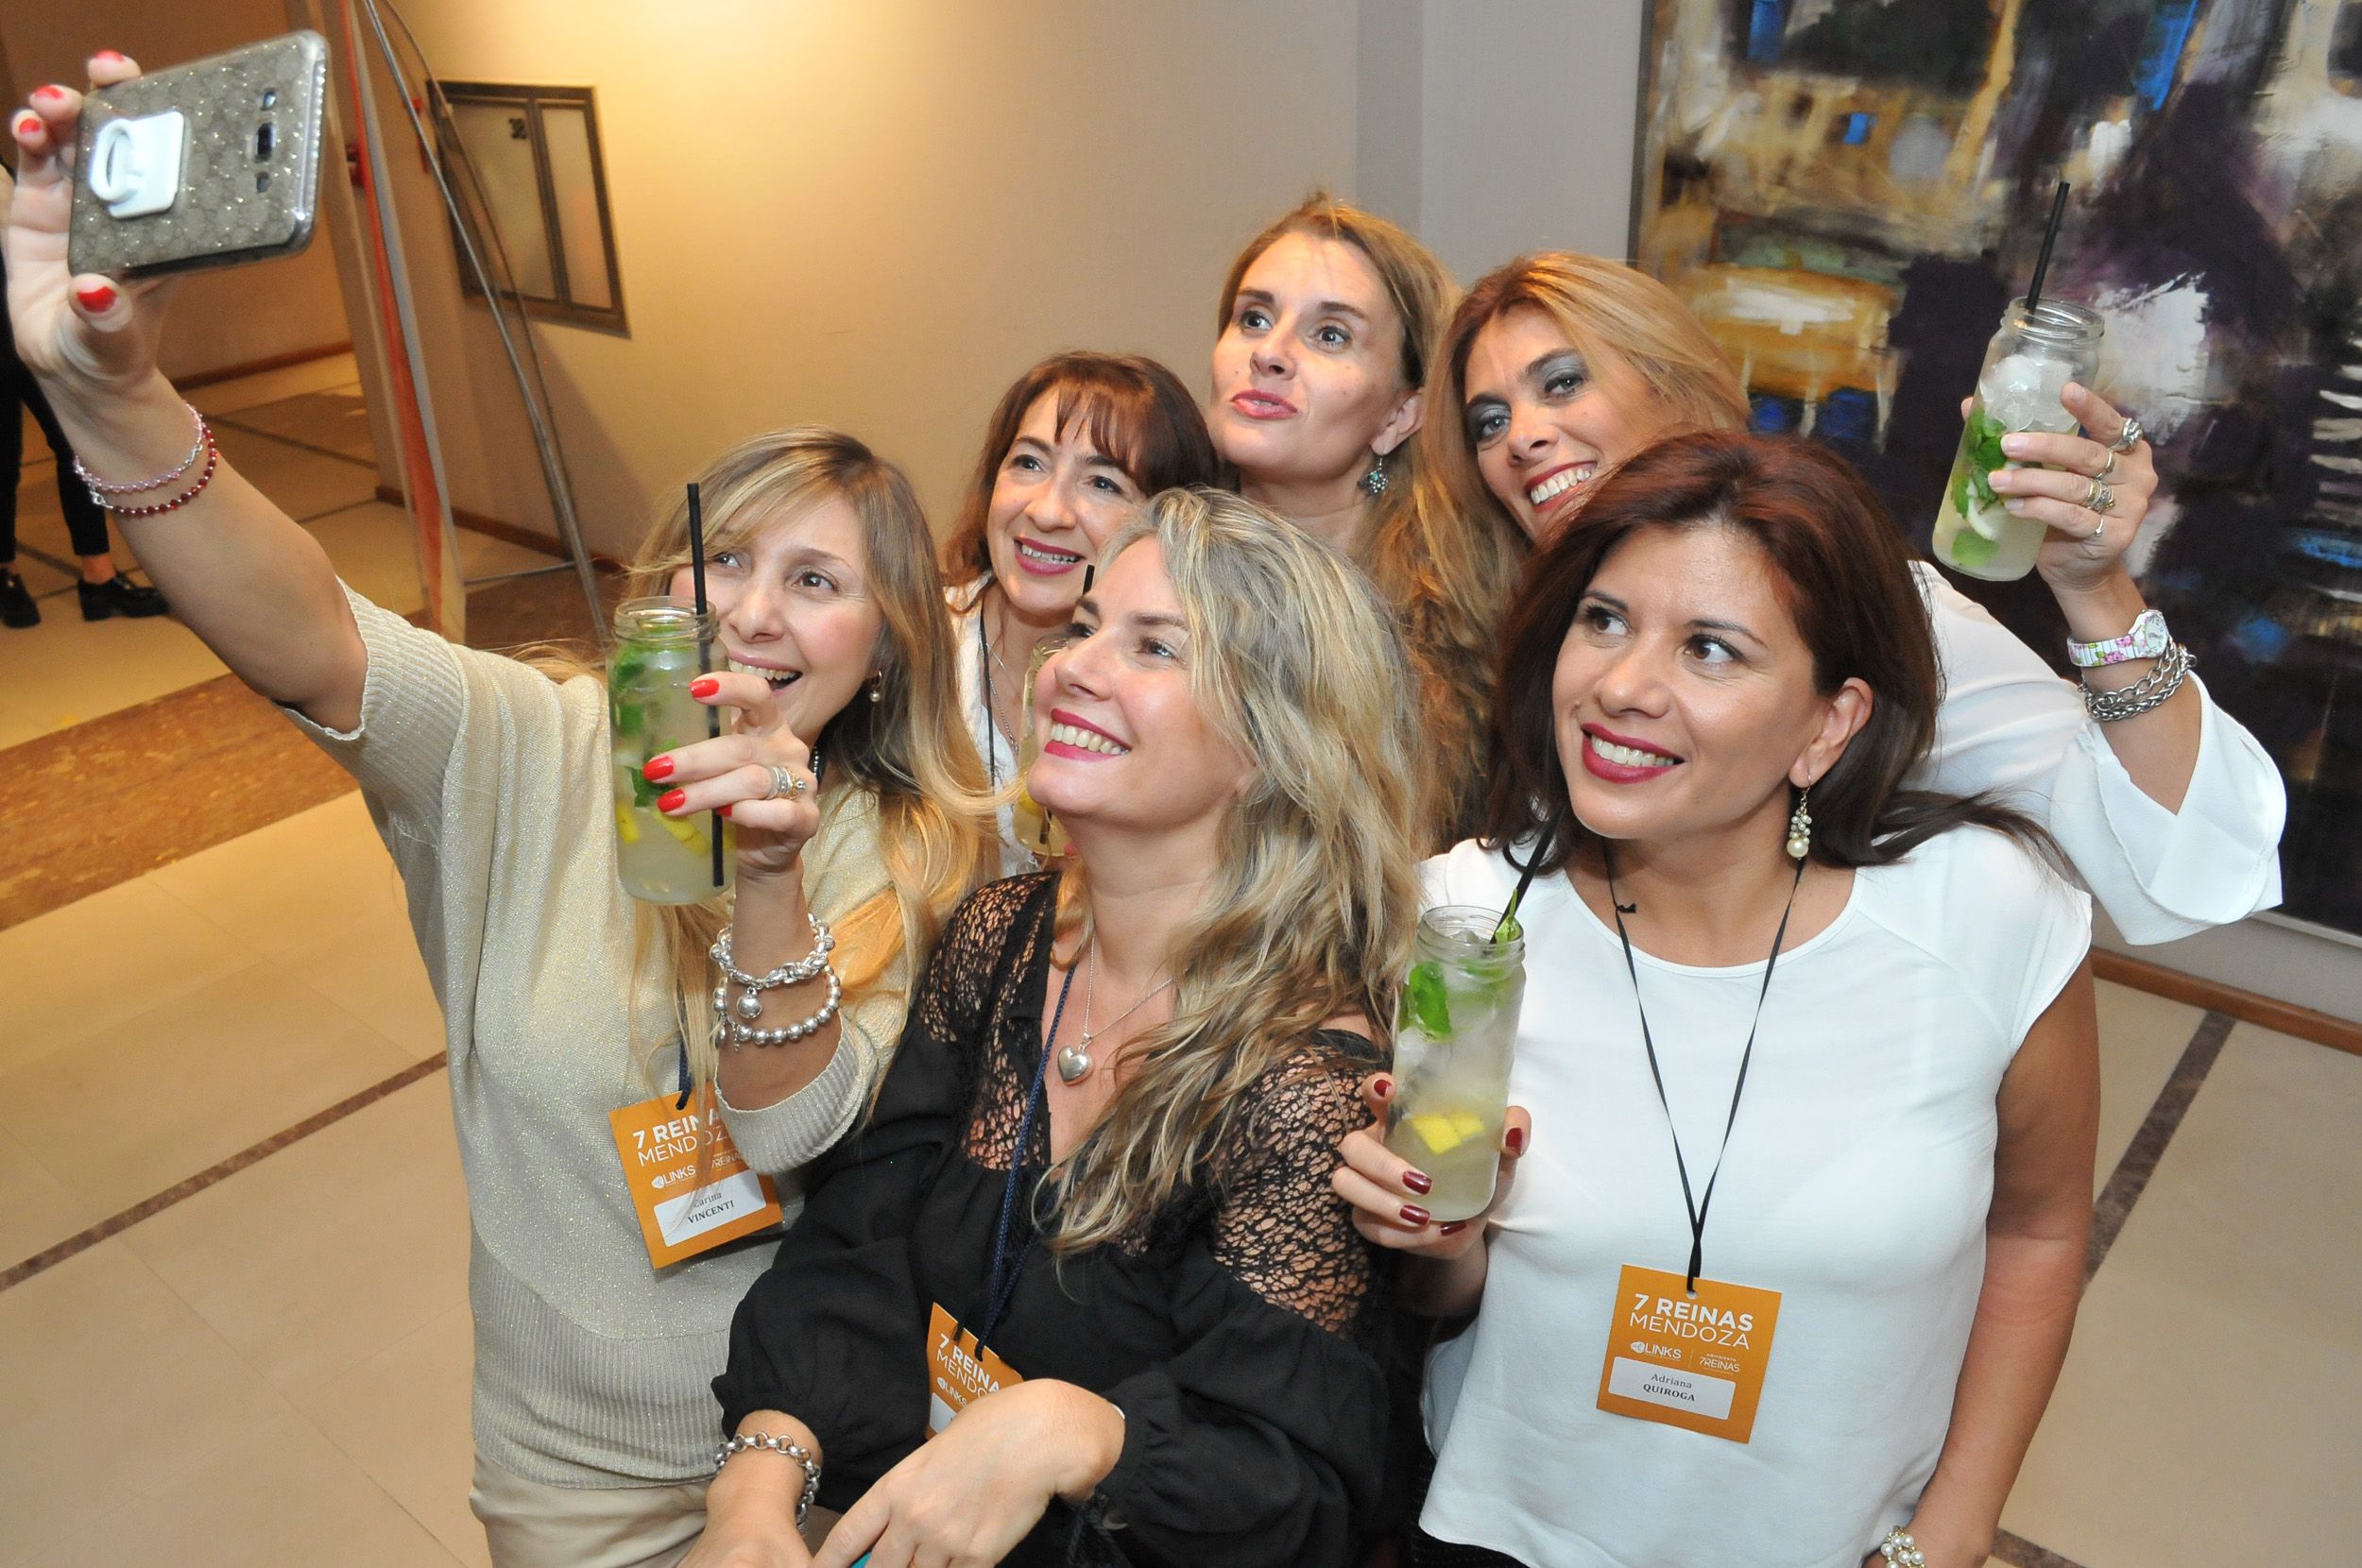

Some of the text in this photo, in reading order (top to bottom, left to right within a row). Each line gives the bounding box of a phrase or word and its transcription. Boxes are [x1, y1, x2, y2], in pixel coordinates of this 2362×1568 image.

[632, 1108, 719, 1150] 7 REINA
[638, 1125, 727, 1167] MENDOZ
[662, 1165, 696, 1185] LINKS
[688, 1200, 734, 1224] VINCENTI
[1634, 1293, 1754, 1332] 7 REINAS
[1630, 1312, 1750, 1350] MENDOZA
[940, 1333, 1000, 1392] 7 REINA
[1645, 1342, 1682, 1359] LINKS
[937, 1349, 987, 1398] MENDO
[1651, 1373, 1692, 1389] Adriana
[945, 1382, 967, 1406] LINKS
[1643, 1384, 1695, 1402] QUIROGA
